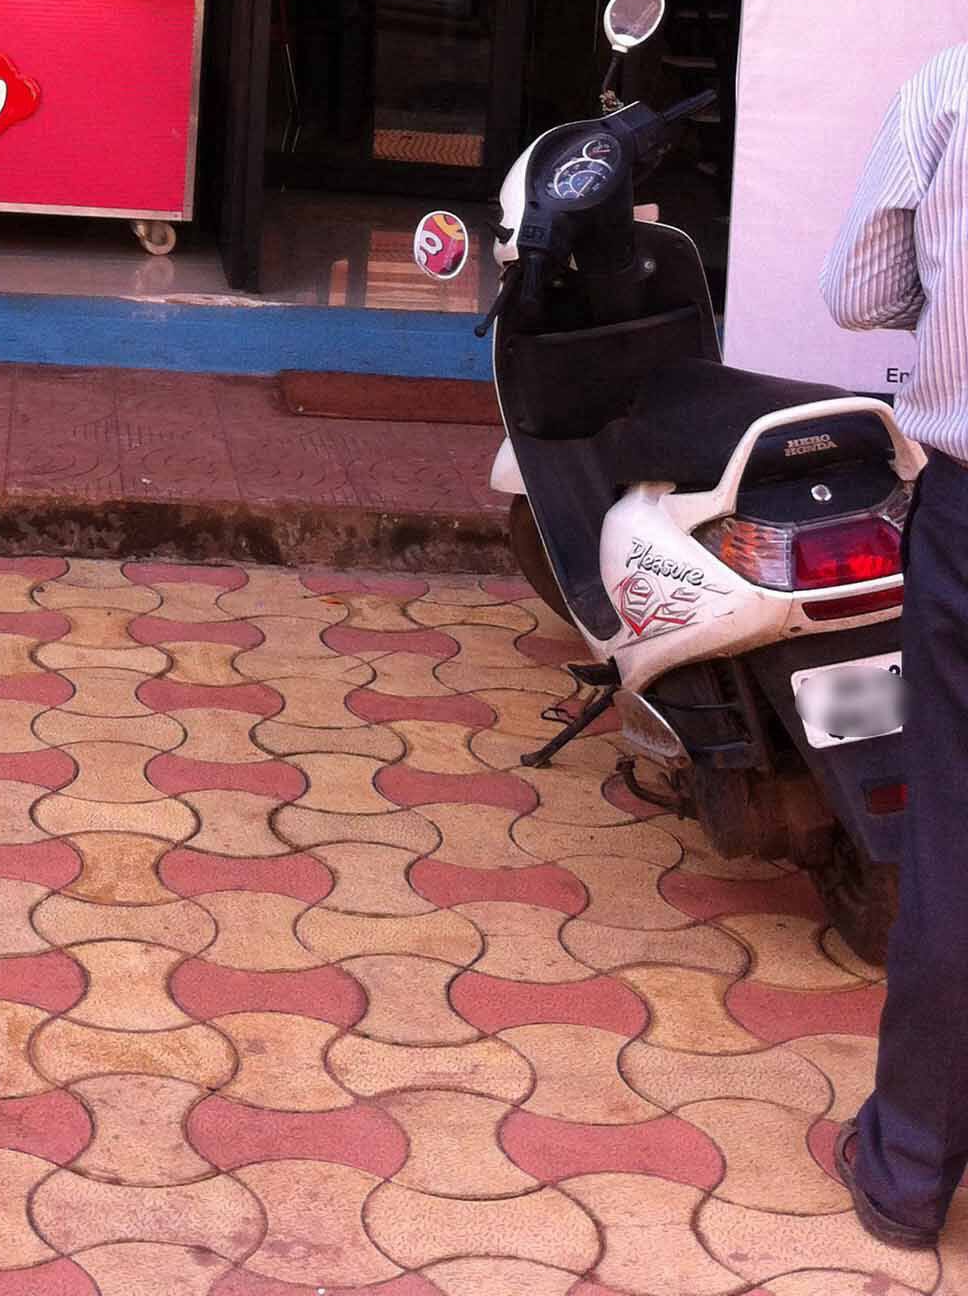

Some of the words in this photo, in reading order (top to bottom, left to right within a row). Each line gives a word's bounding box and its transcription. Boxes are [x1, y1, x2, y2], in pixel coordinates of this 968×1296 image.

[786, 433, 831, 448] HERO
[784, 441, 839, 457] HONDA
[625, 536, 705, 586] Pleasure
